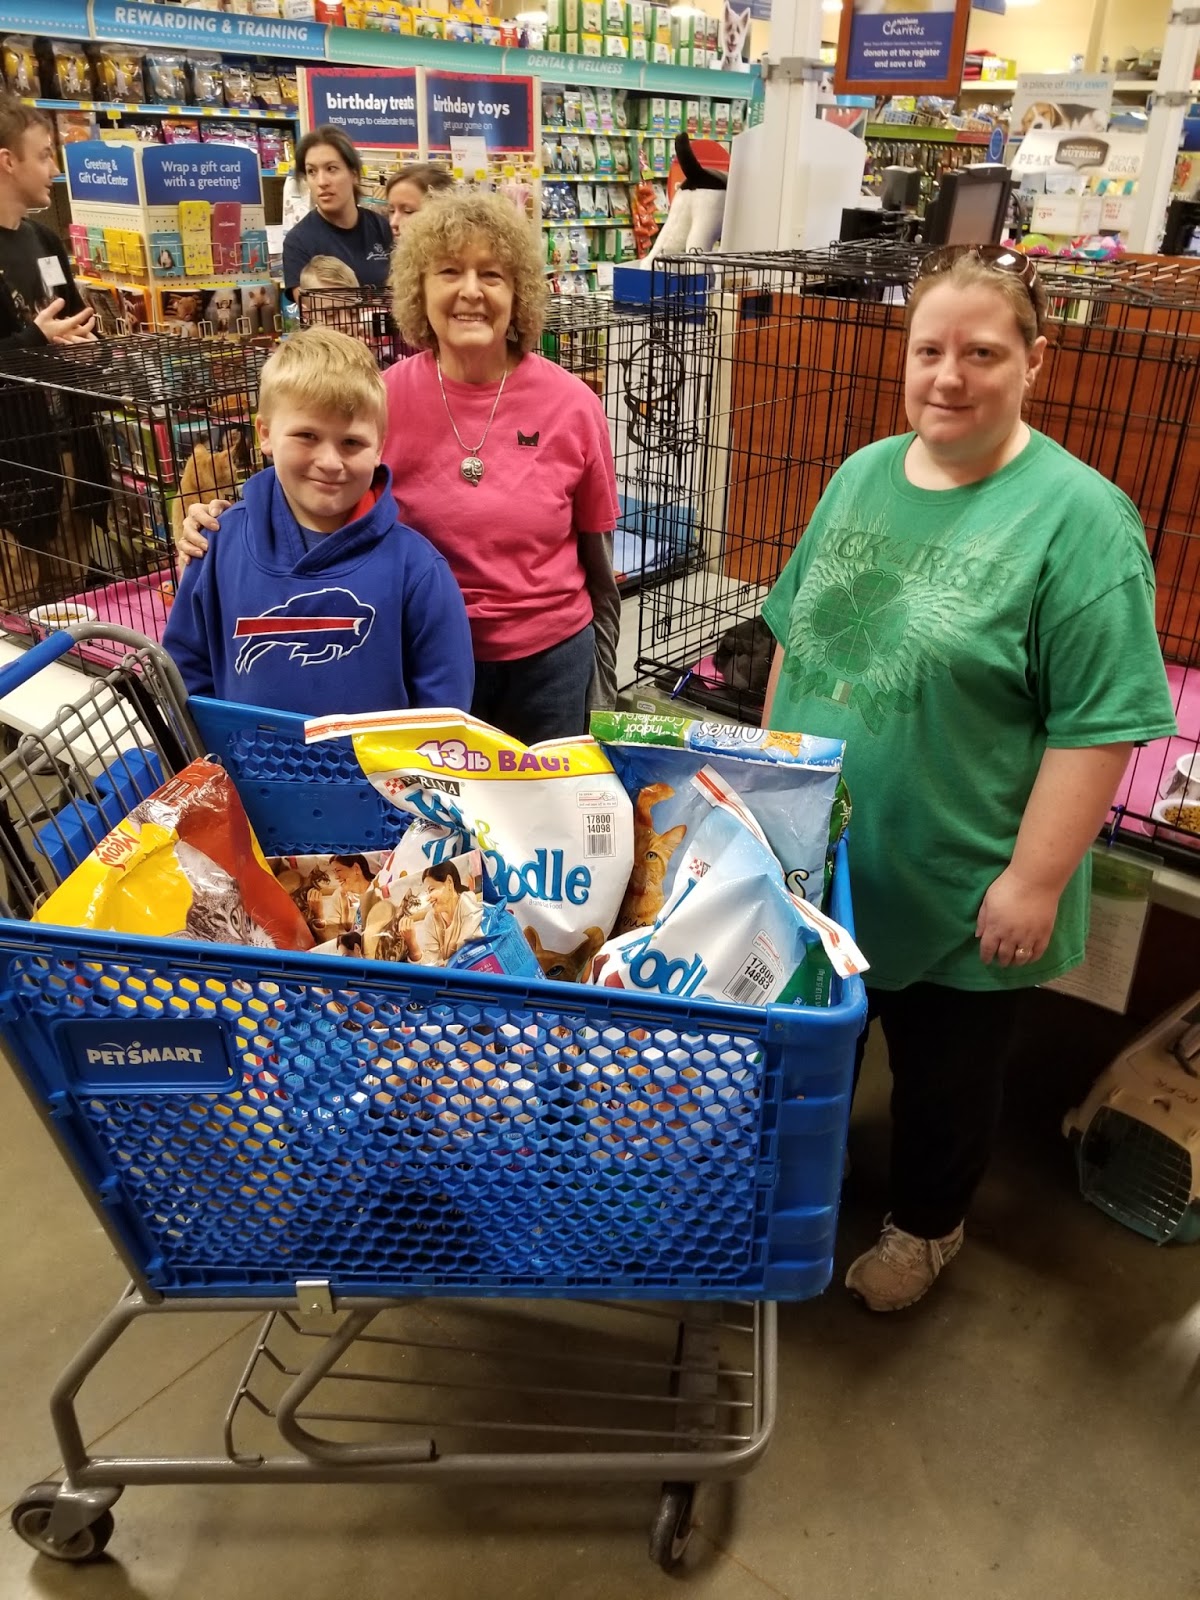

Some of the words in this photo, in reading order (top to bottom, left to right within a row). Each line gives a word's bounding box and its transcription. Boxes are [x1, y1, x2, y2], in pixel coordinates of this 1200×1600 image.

[115, 7, 217, 33] REWARDING
[222, 19, 232, 34] &
[237, 21, 308, 41] TRAINING
[883, 20, 925, 36] Charities
[863, 48, 888, 57] donate
[899, 48, 911, 57] the
[912, 48, 940, 58] register
[527, 54, 565, 71] DENTAL
[577, 60, 624, 75] WELLNESS
[874, 60, 889, 68] and
[914, 59, 926, 68] life
[1029, 80, 1053, 91] place
[1056, 79, 1065, 89] of
[326, 92, 388, 114] birthday
[389, 96, 415, 110] treats
[433, 94, 475, 118] birthday
[478, 100, 510, 119] toys
[328, 116, 346, 125] tasty
[347, 117, 365, 126] ways
[365, 117, 373, 125] to
[373, 117, 399, 126] celebrate
[443, 121, 451, 130] get
[452, 122, 463, 131] your
[464, 122, 482, 131] game
[1019, 153, 1053, 166] PEAK
[1061, 149, 1101, 159] NUTRISH
[84, 158, 111, 173] Greeting
[111, 160, 118, 171] &
[161, 161, 189, 176] Wrap
[191, 164, 198, 172] a
[200, 161, 217, 176] gift
[220, 161, 241, 173] card
[79, 172, 91, 184] Gift
[91, 173, 107, 185] Card
[107, 174, 128, 186] Center
[164, 175, 188, 187] with
[189, 179, 196, 187] a
[198, 176, 241, 190] greeting!
[498, 750, 571, 772] BAG!
[402, 775, 459, 795] PRINA
[586, 814, 611, 824] 17800
[587, 824, 611, 833] 14098
[751, 957, 775, 983] 17800
[744, 966, 770, 990] 14883
[86, 1046, 203, 1066] PETSMART
